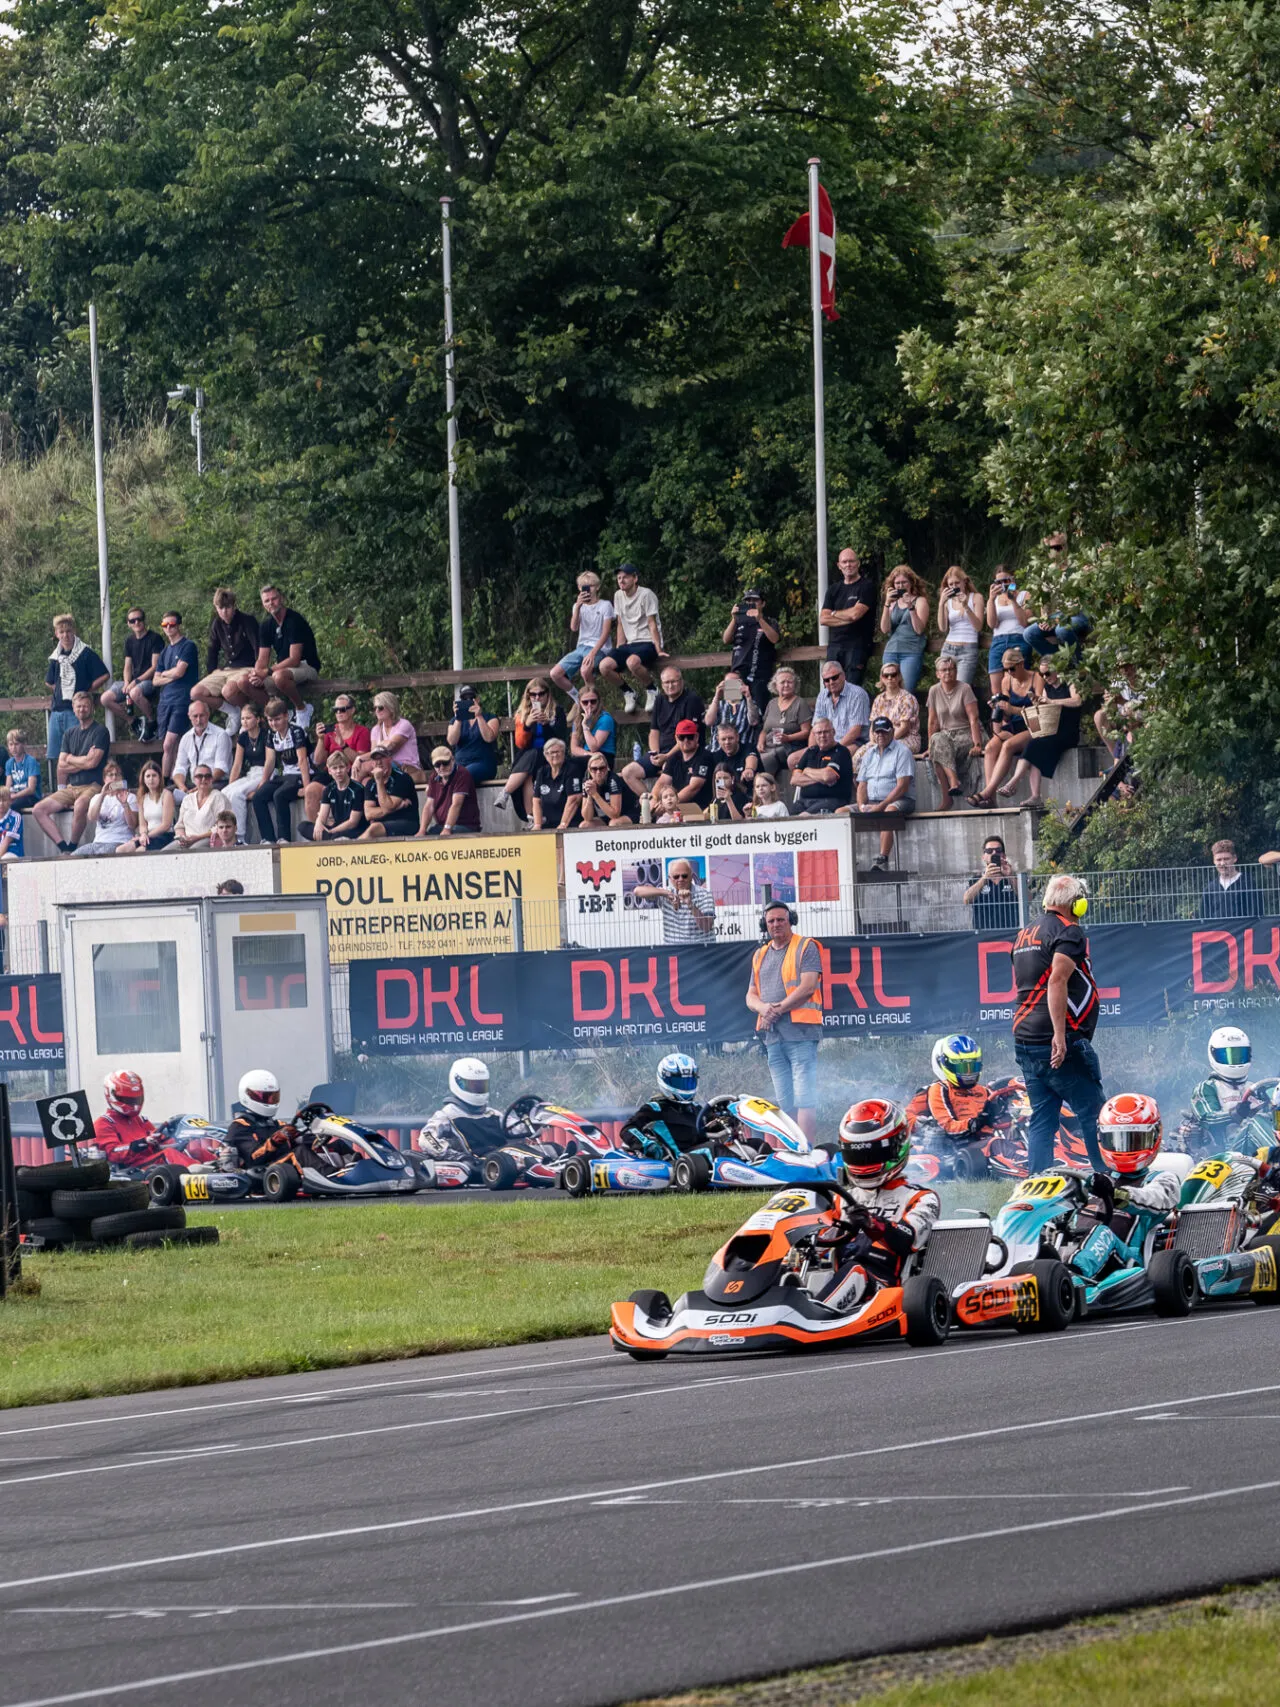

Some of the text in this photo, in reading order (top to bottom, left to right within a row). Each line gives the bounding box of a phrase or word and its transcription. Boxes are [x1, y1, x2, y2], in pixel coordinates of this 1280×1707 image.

[595, 828, 818, 854] Betonprodukter til godt dansk byggeri
[434, 850, 449, 861] OG
[451, 846, 522, 860] VEJARBEJDER
[316, 869, 523, 905] POUL HANSEN
[328, 909, 512, 936] NTREPRENØRER A/
[338, 941, 388, 952] GRINDSTED
[417, 938, 437, 950] 7532
[438, 937, 457, 949] 0411
[570, 956, 706, 1022] DKL
[822, 946, 911, 1010] KL
[376, 965, 503, 1030] DKL
[0, 986, 64, 1044] KL
[870, 1011, 912, 1025] LEAGUE
[378, 1029, 504, 1046] DANISH KARTING LEAGUE
[573, 1020, 707, 1038] DANISH KARTING LEAGUE
[29, 1048, 64, 1060] LEAGUE
[48, 1098, 86, 1141] 8
[186, 1175, 207, 1198] 130
[964, 1286, 1010, 1315] SODI
[703, 1313, 759, 1326] SODI
[865, 1304, 897, 1326] SODI
